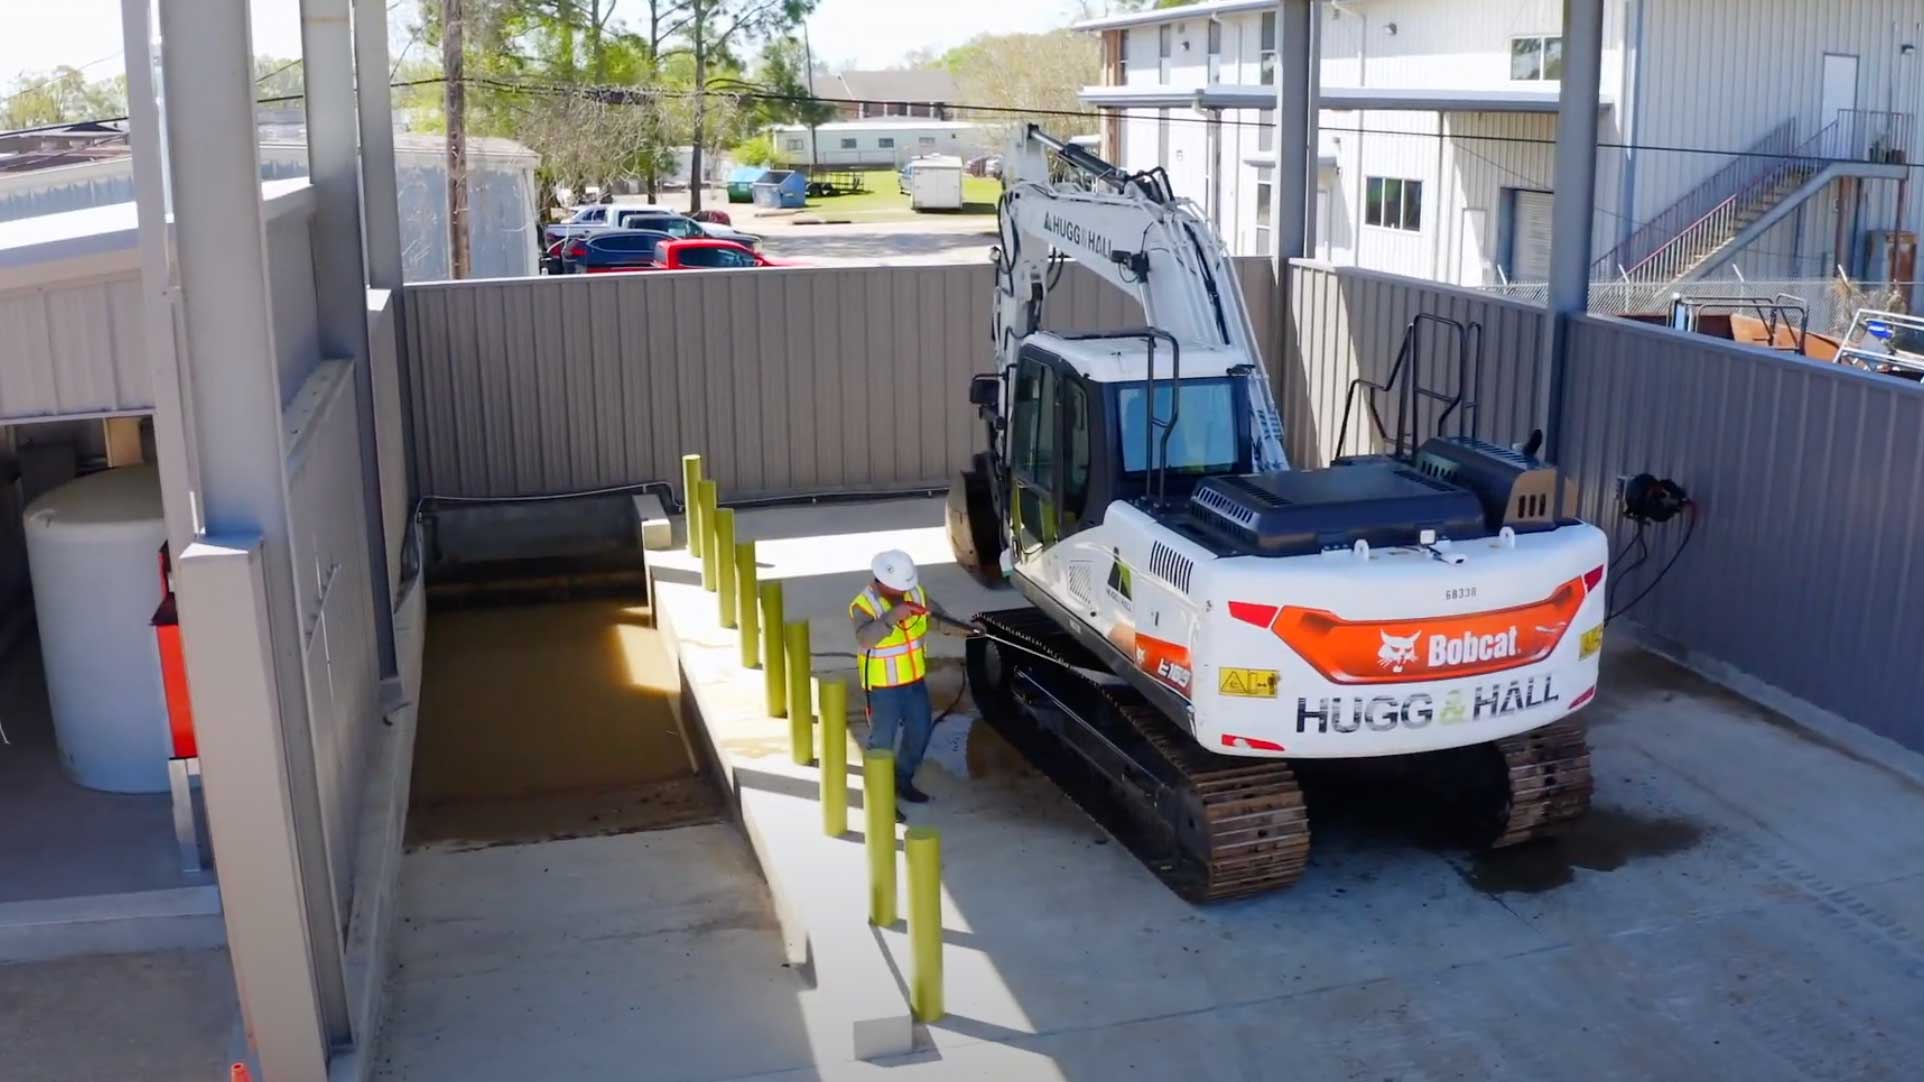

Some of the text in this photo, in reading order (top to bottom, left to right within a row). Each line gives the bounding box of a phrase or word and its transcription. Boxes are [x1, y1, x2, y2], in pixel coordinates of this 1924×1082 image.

[1052, 215, 1080, 245] HUGG
[1428, 626, 1518, 667] Bobcat
[1296, 675, 1559, 733] HUGG & HALL
